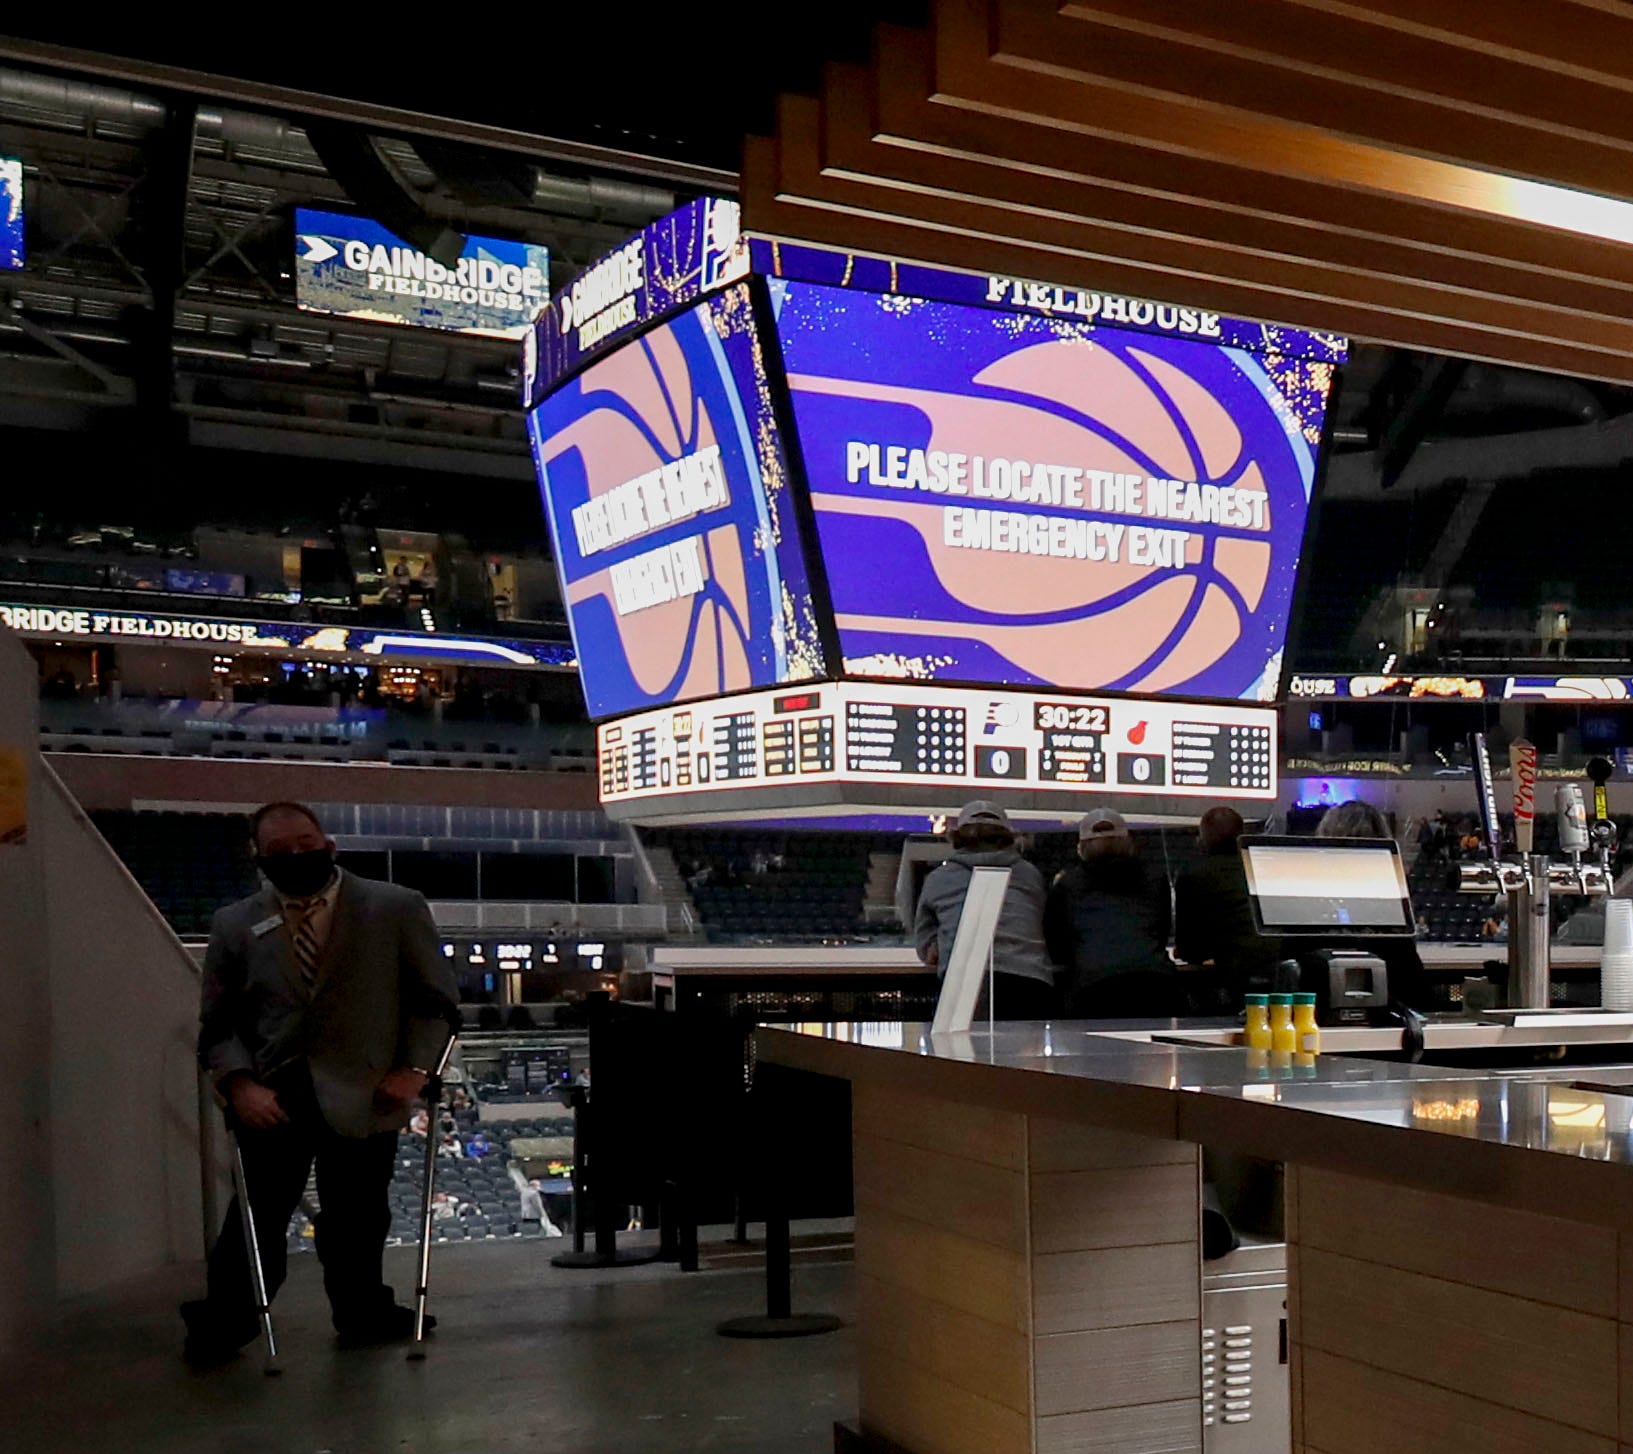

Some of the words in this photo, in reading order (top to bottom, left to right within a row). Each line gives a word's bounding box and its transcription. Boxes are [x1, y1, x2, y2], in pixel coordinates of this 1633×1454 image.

[368, 273, 523, 311] FIELDHOUSE
[986, 275, 1221, 337] FIELDHOUSE
[846, 441, 968, 495] PLEASE
[972, 455, 1084, 507] LOCATE
[1086, 468, 1143, 515] THE
[1147, 477, 1270, 530] NEAREST
[943, 505, 1125, 563] EMERGENCY
[1127, 526, 1191, 569] EXIT
[92, 615, 259, 641] FIELDHOUSE
[1038, 705, 1106, 732] 30:22
[990, 750, 1010, 775] 0
[1132, 757, 1150, 781] 0
[1513, 746, 1537, 820] Coors
